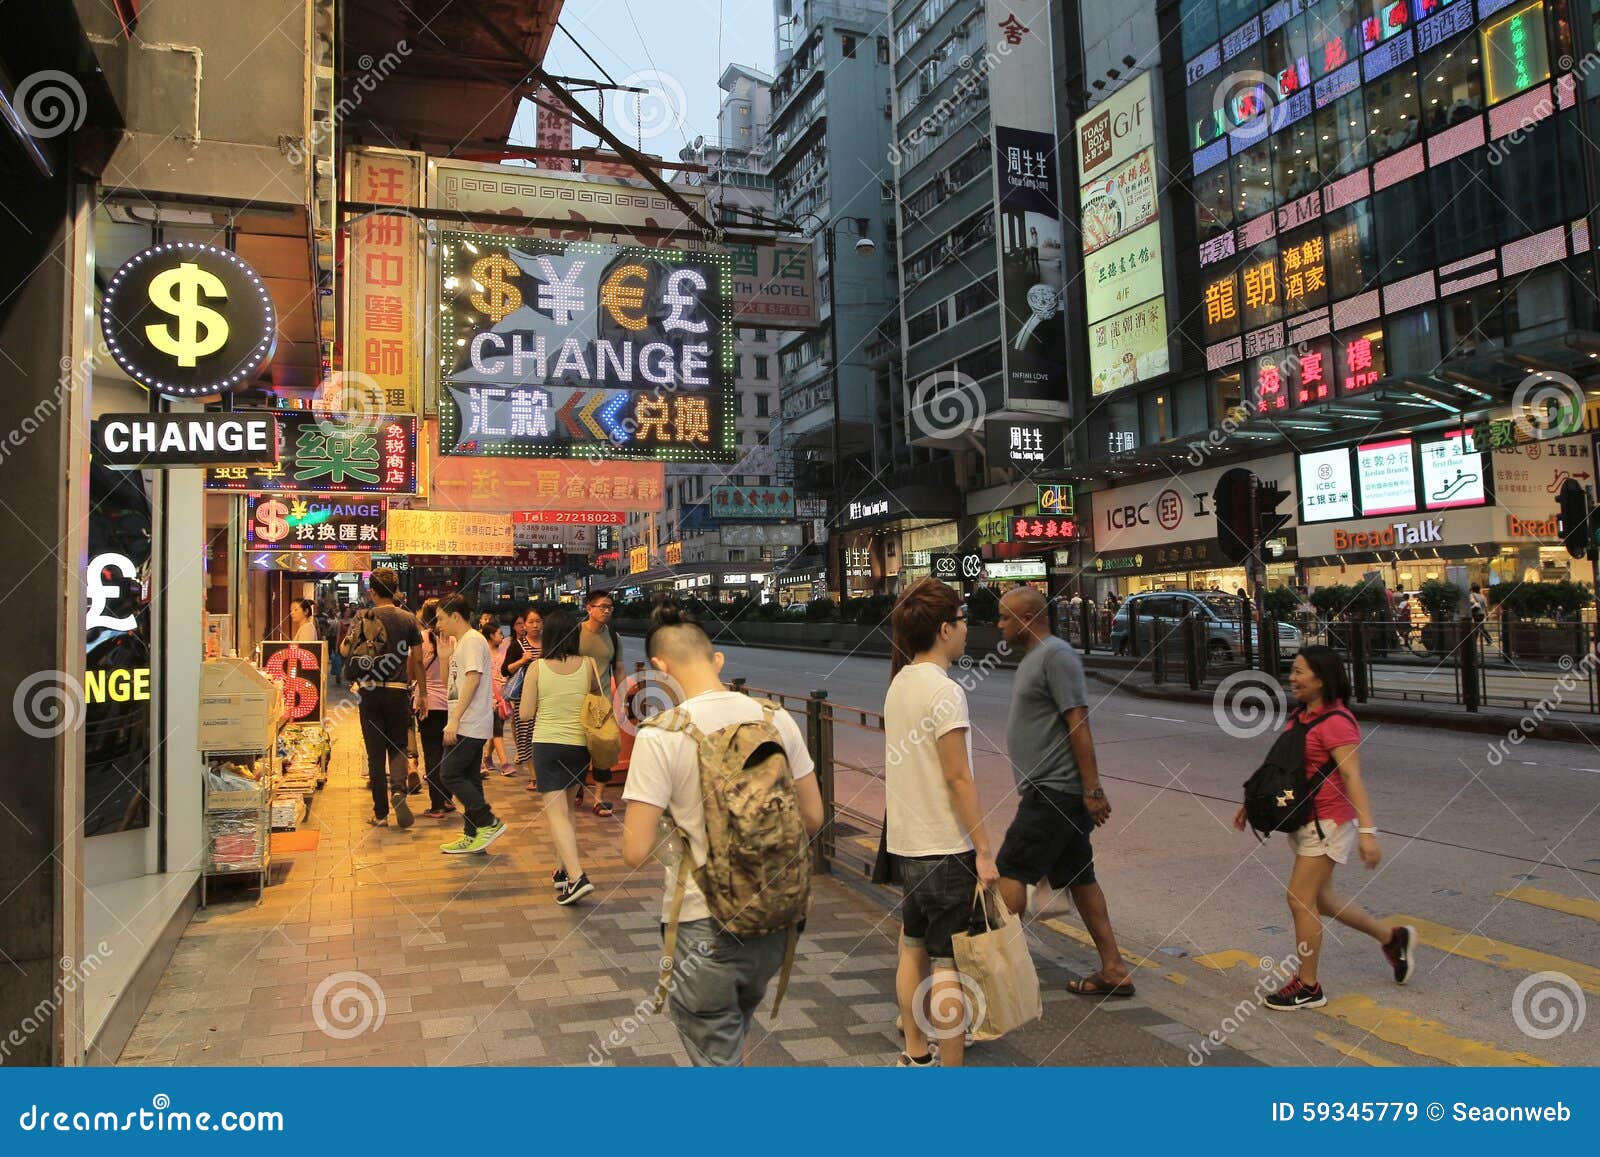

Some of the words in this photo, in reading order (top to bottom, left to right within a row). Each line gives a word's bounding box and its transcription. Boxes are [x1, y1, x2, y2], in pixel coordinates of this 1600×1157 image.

[998, 14, 1029, 45] 舍
[1083, 116, 1110, 142] TOAST
[1113, 97, 1147, 138] G/F
[1088, 131, 1106, 150] BOX
[1007, 146, 1049, 179] 周生生
[1282, 236, 1324, 273] 海鮮
[471, 253, 522, 323] $
[601, 264, 649, 332] €
[662, 269, 710, 335] £
[760, 283, 809, 298] HOTEL
[1206, 261, 1278, 325] 龍朝
[1285, 266, 1326, 300] 酒家
[145, 263, 230, 368] $
[470, 332, 711, 387] CHANGE
[364, 386, 406, 407] 主理
[469, 388, 550, 437] 汇款
[102, 421, 268, 453] CHANGE
[1010, 427, 1043, 451] 周生生
[293, 421, 381, 484] 藥
[1361, 452, 1409, 469] 佐敦分行
[1316, 481, 1336, 491] ICBC
[1387, 466, 1409, 476] Branch
[308, 504, 380, 517] CHANGE
[1306, 492, 1349, 506] 工银亚洲
[523, 512, 548, 521] Tel:
[557, 513, 617, 522] 27218023
[1107, 502, 1150, 531] ICBC
[1334, 517, 1443, 551] BreadTalk
[1104, 556, 1135, 570] ROLEX
